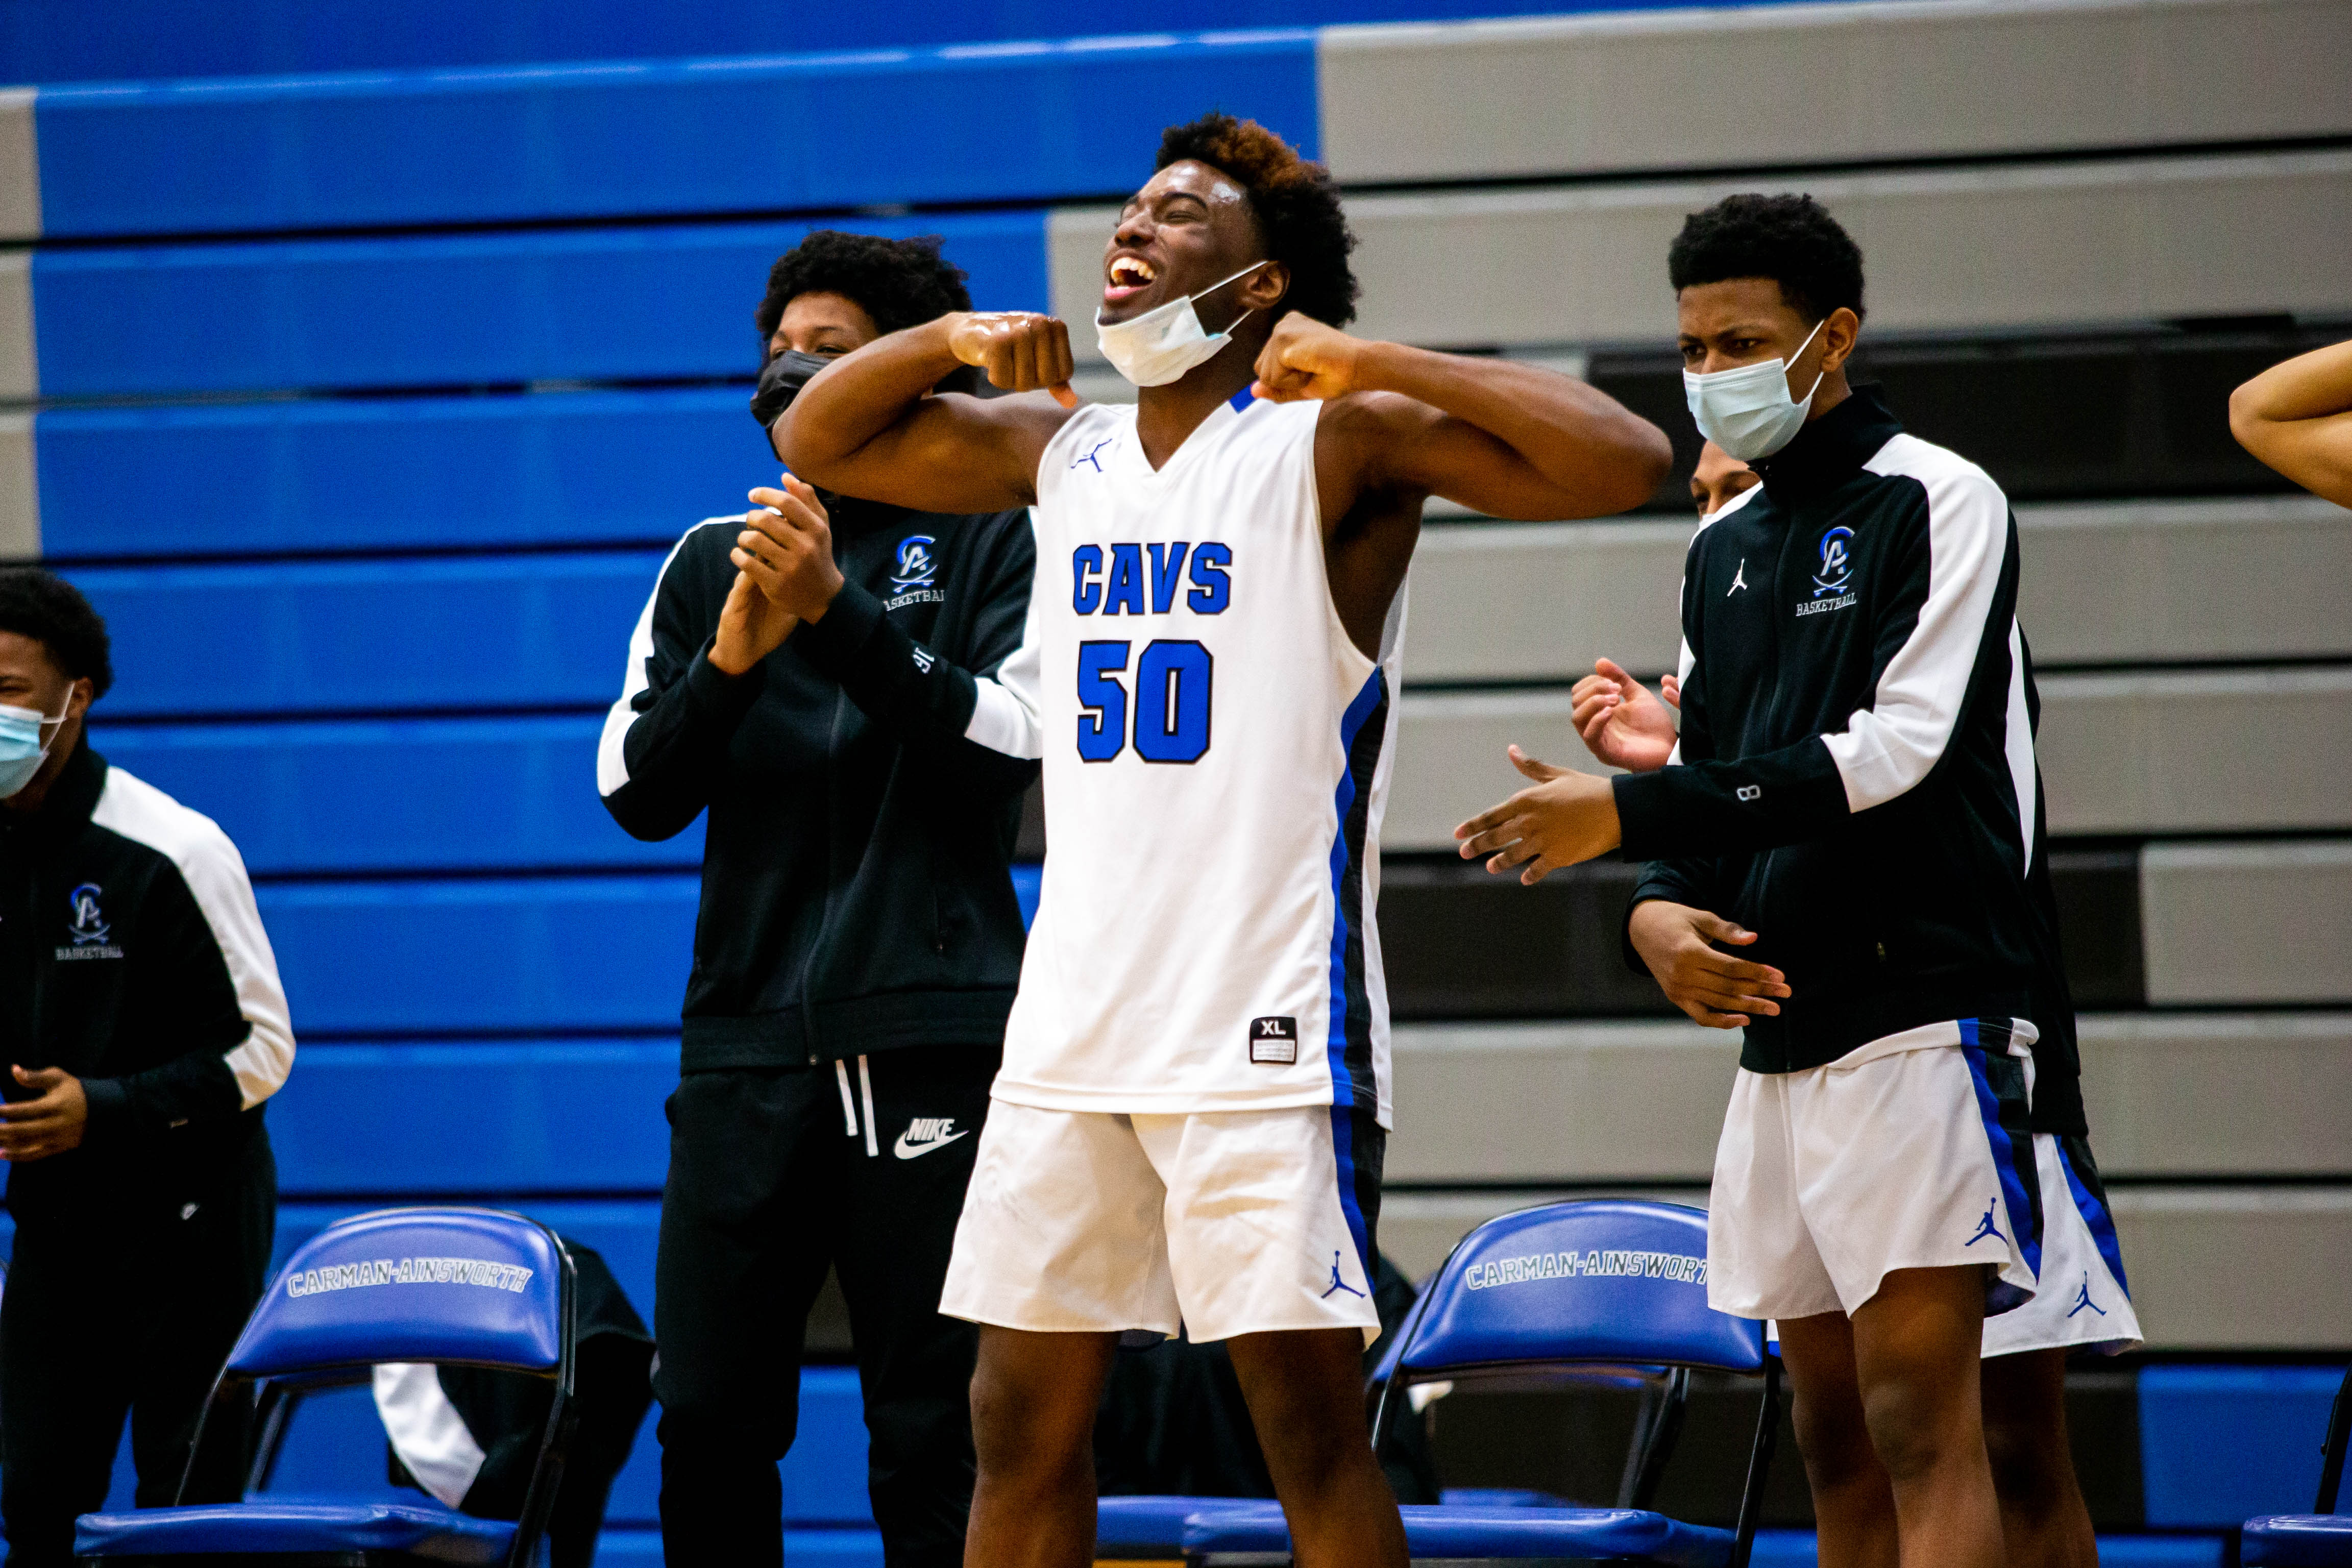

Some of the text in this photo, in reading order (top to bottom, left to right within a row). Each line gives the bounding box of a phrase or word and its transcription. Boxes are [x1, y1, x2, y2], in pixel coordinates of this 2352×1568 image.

[1072, 542, 1233, 616] CAVS
[882, 590, 944, 611] ASKETBAL
[1796, 593, 1856, 616] BASKETBALL
[1076, 639, 1214, 765] 50
[1261, 1020, 1286, 1035] XL
[906, 1118, 954, 1141] NIKE
[286, 1257, 533, 1297] CARMAN-AINSWORTH
[1466, 1250, 1708, 1290] CARMAN-AINSWORT
